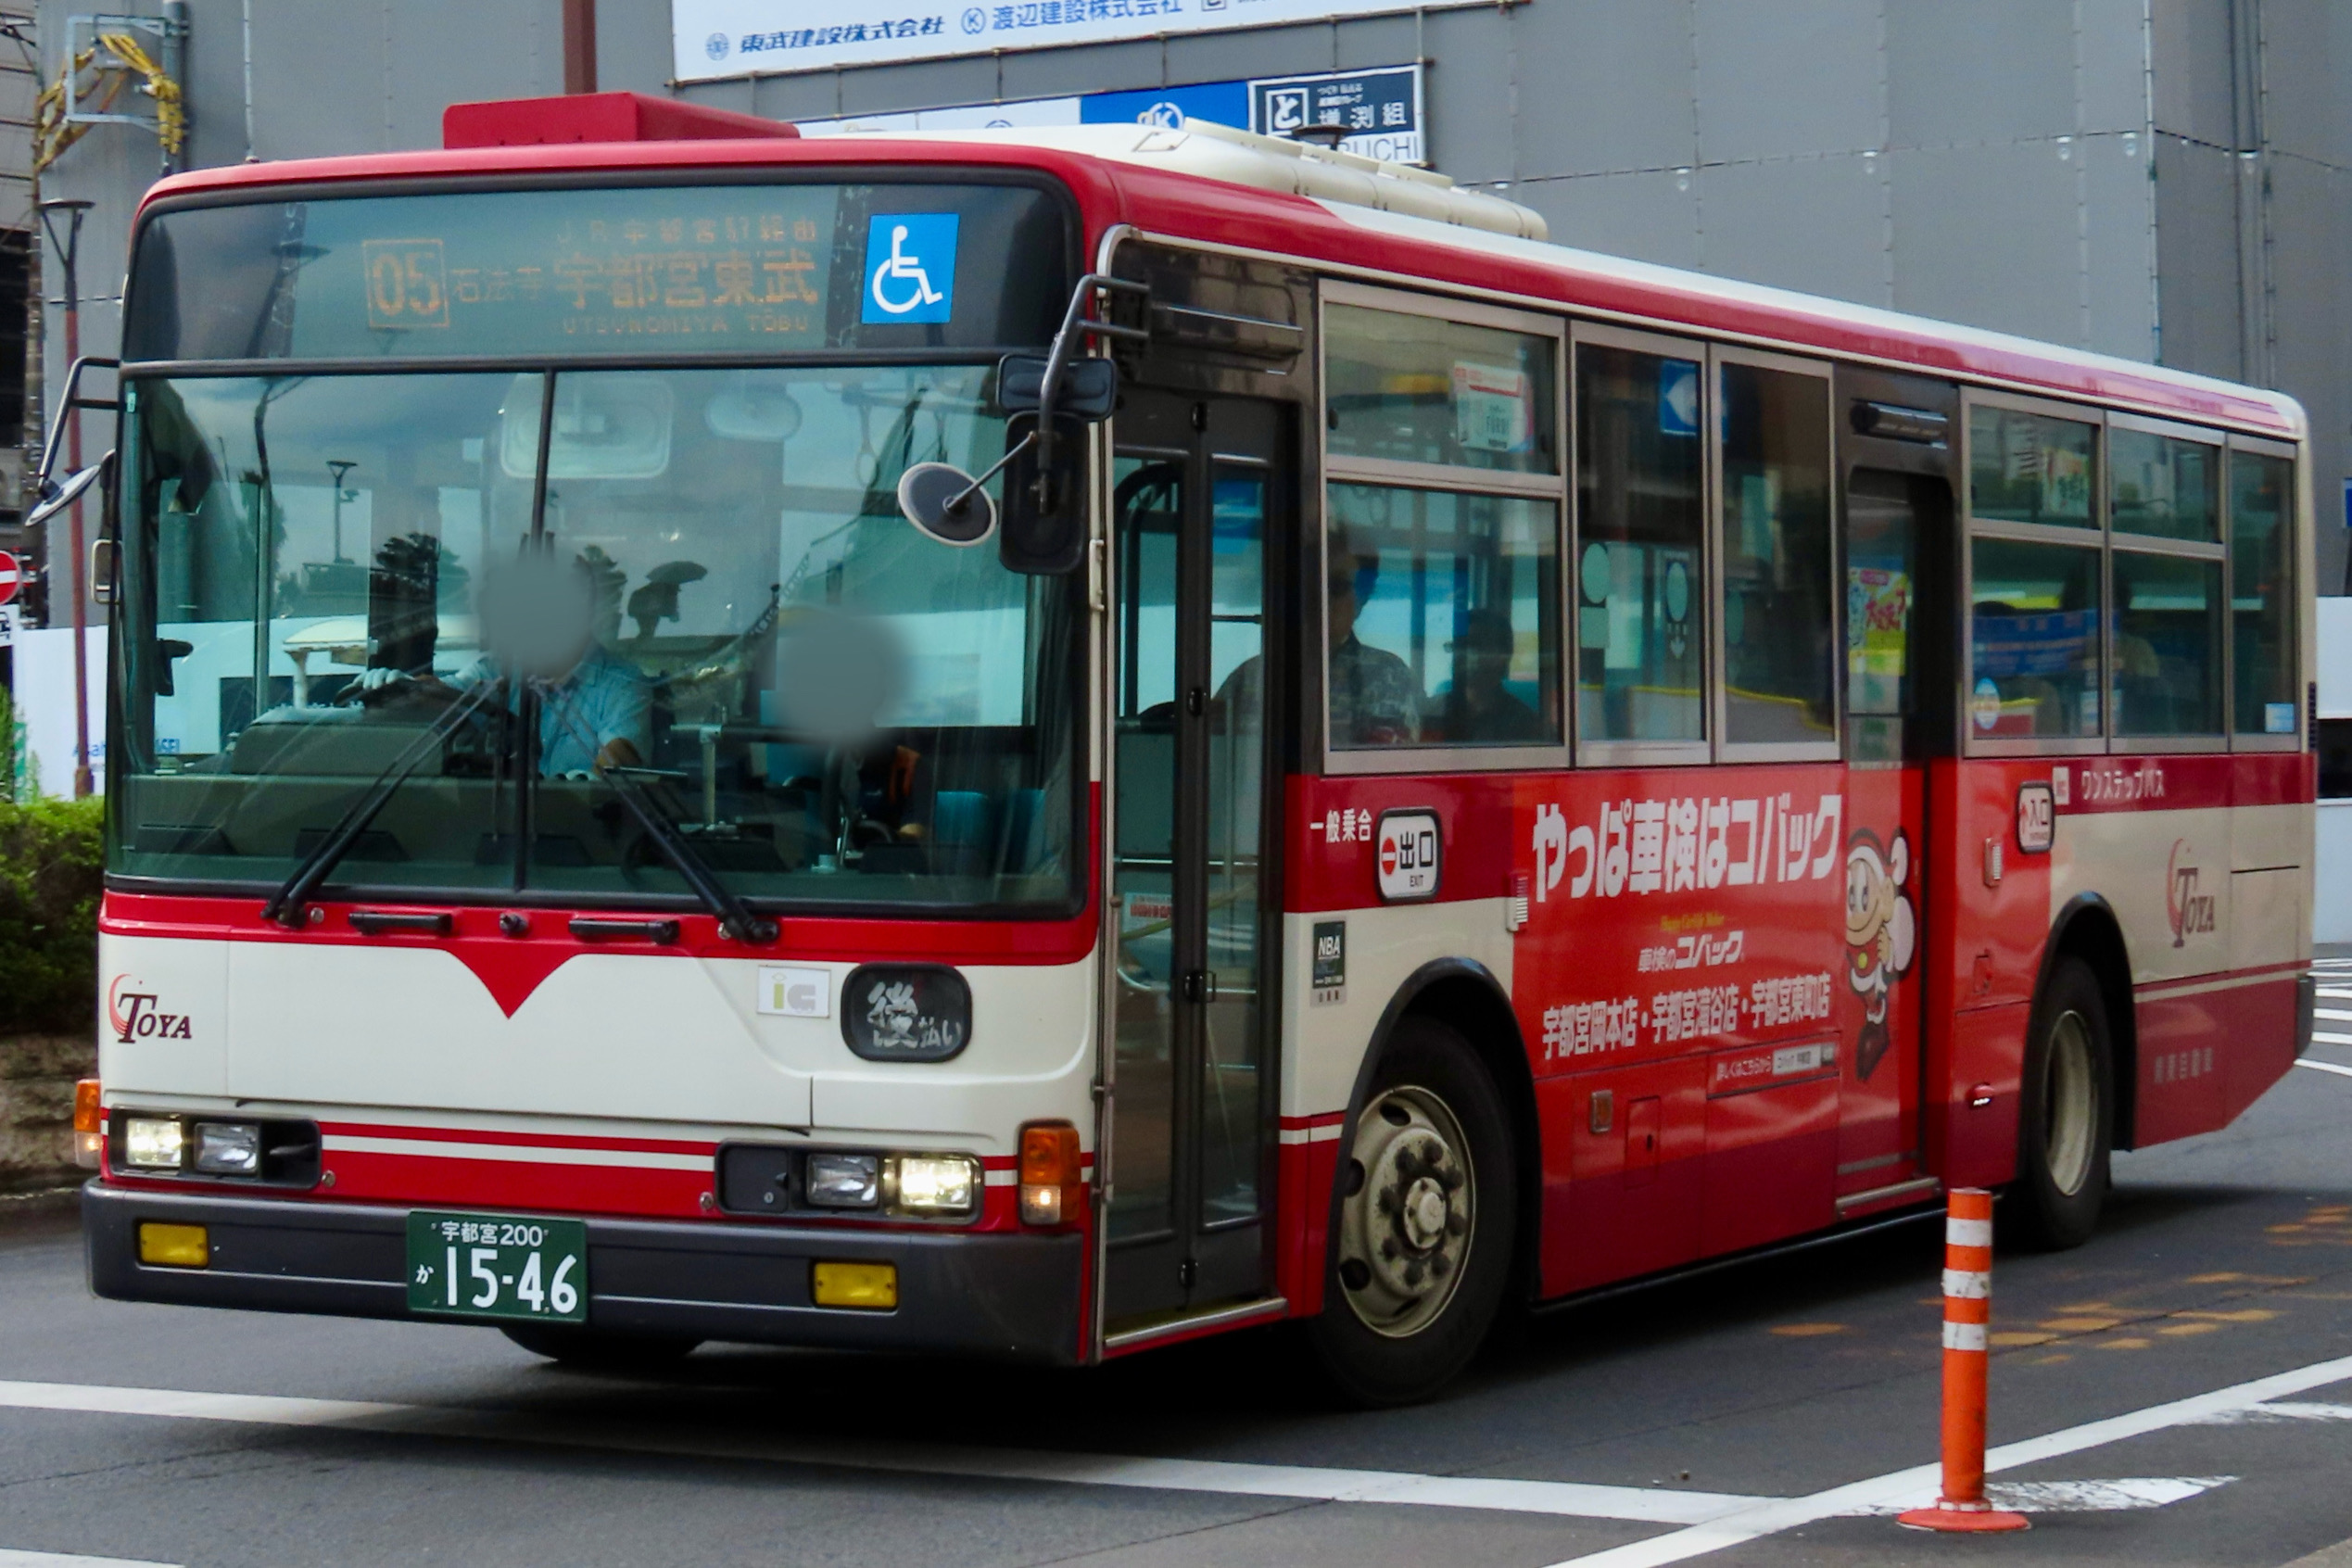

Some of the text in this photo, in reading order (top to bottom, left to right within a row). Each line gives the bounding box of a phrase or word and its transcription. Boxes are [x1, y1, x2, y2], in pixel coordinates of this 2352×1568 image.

[739, 16, 946, 54] 東武建設株式会社
[992, 0, 1183, 31] 渡辺建設株式会社
[373, 251, 441, 317] 05
[553, 248, 818, 310] 宇都宮東武
[2081, 769, 2165, 800] ワンステップバス
[1309, 808, 1372, 843] 一般乗合
[1399, 830, 1434, 869] 出口
[1532, 792, 1842, 903] やっぱ車検はコバック
[1318, 934, 1341, 956] NBA
[1638, 929, 1744, 973] 車検のコバック
[415, 1246, 578, 1314] か 15-46
